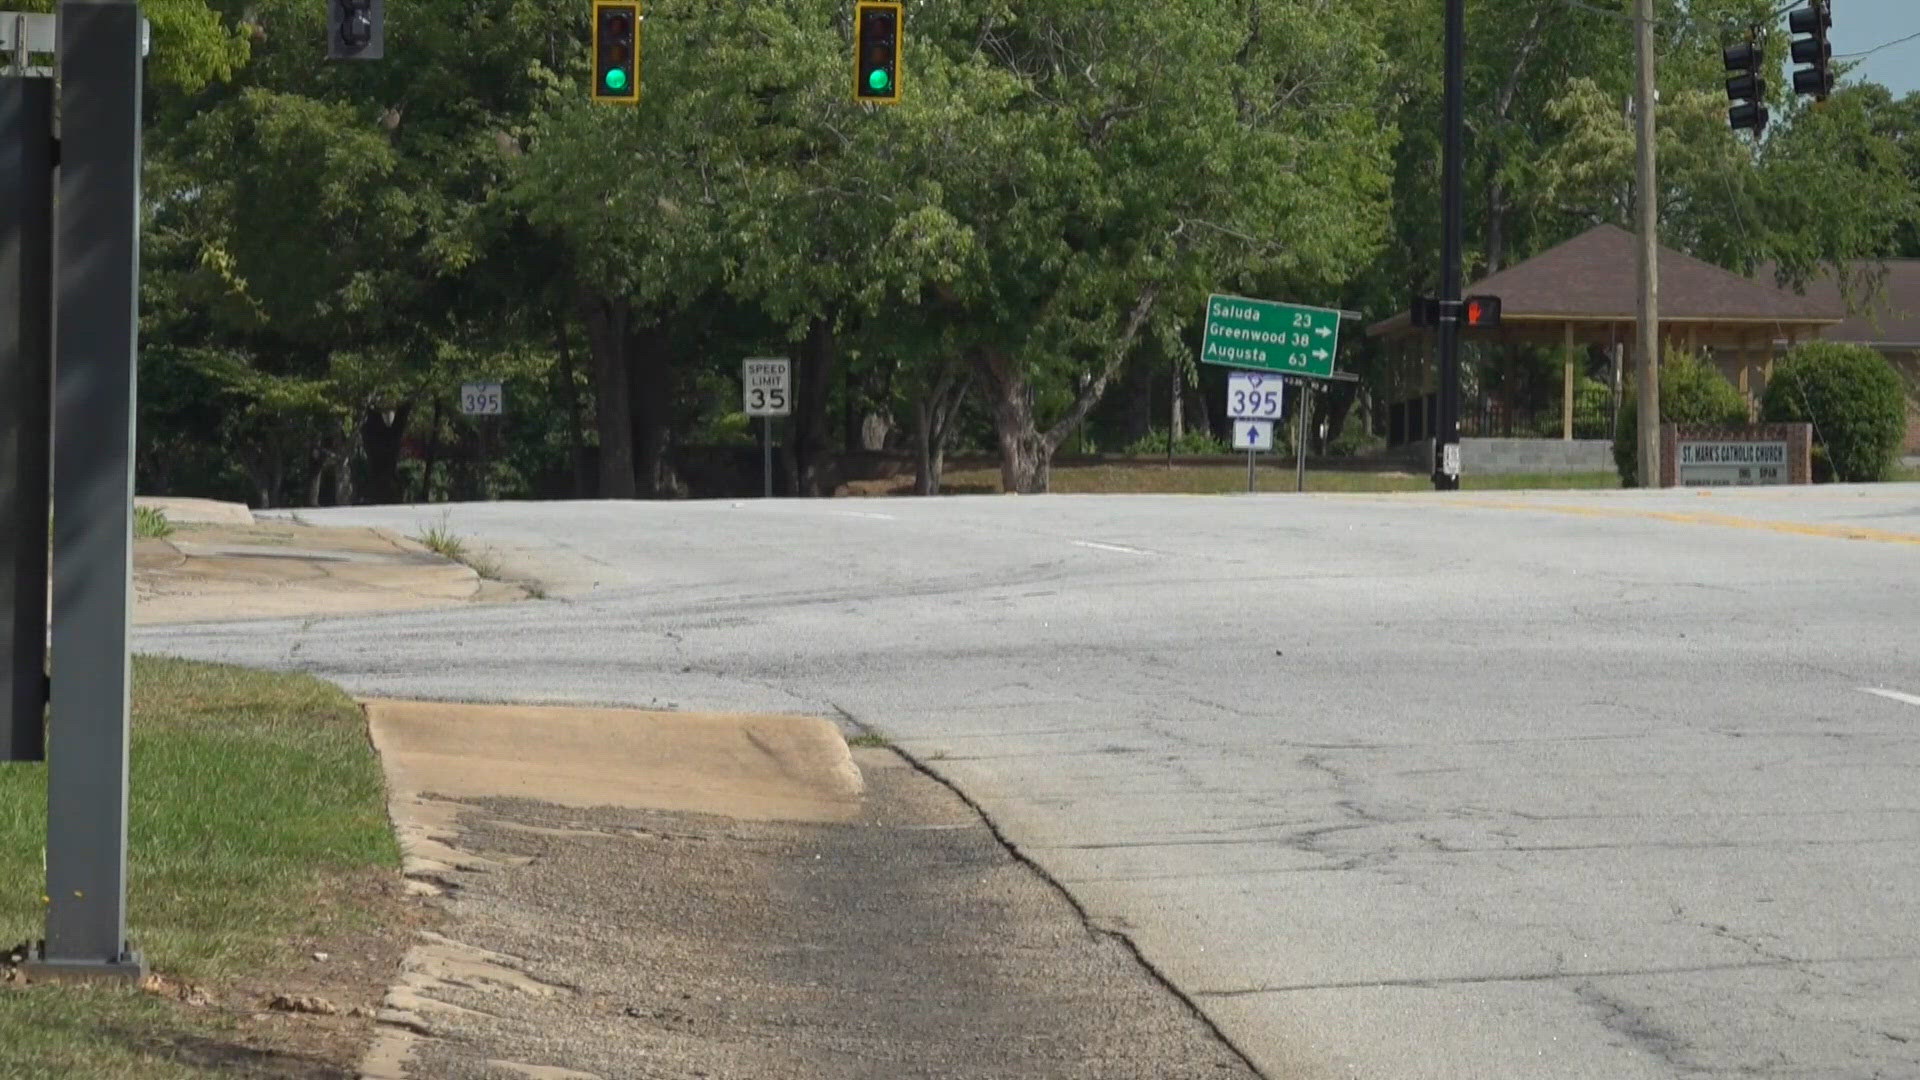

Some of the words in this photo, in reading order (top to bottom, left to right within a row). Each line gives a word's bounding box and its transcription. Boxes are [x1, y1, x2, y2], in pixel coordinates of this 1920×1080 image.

[1213, 303, 1260, 321] Saluda
[1293, 313, 1312, 327] 23
[1210, 323, 1286, 344] Greenwood
[1291, 333, 1310, 347] 38
[1208, 342, 1267, 361] Augusta
[1288, 353, 1307, 366] 63
[749, 364, 786, 374] SPEED
[752, 376, 781, 387] LIMIT
[465, 394, 498, 412] 395
[751, 388, 785, 409] 35
[1233, 390, 1278, 415] 395
[1683, 445, 1693, 463] ST.
[1695, 445, 1719, 463] MARK'S
[1721, 445, 1754, 463] CATHOLIC
[1755, 445, 1783, 463] CHURCH
